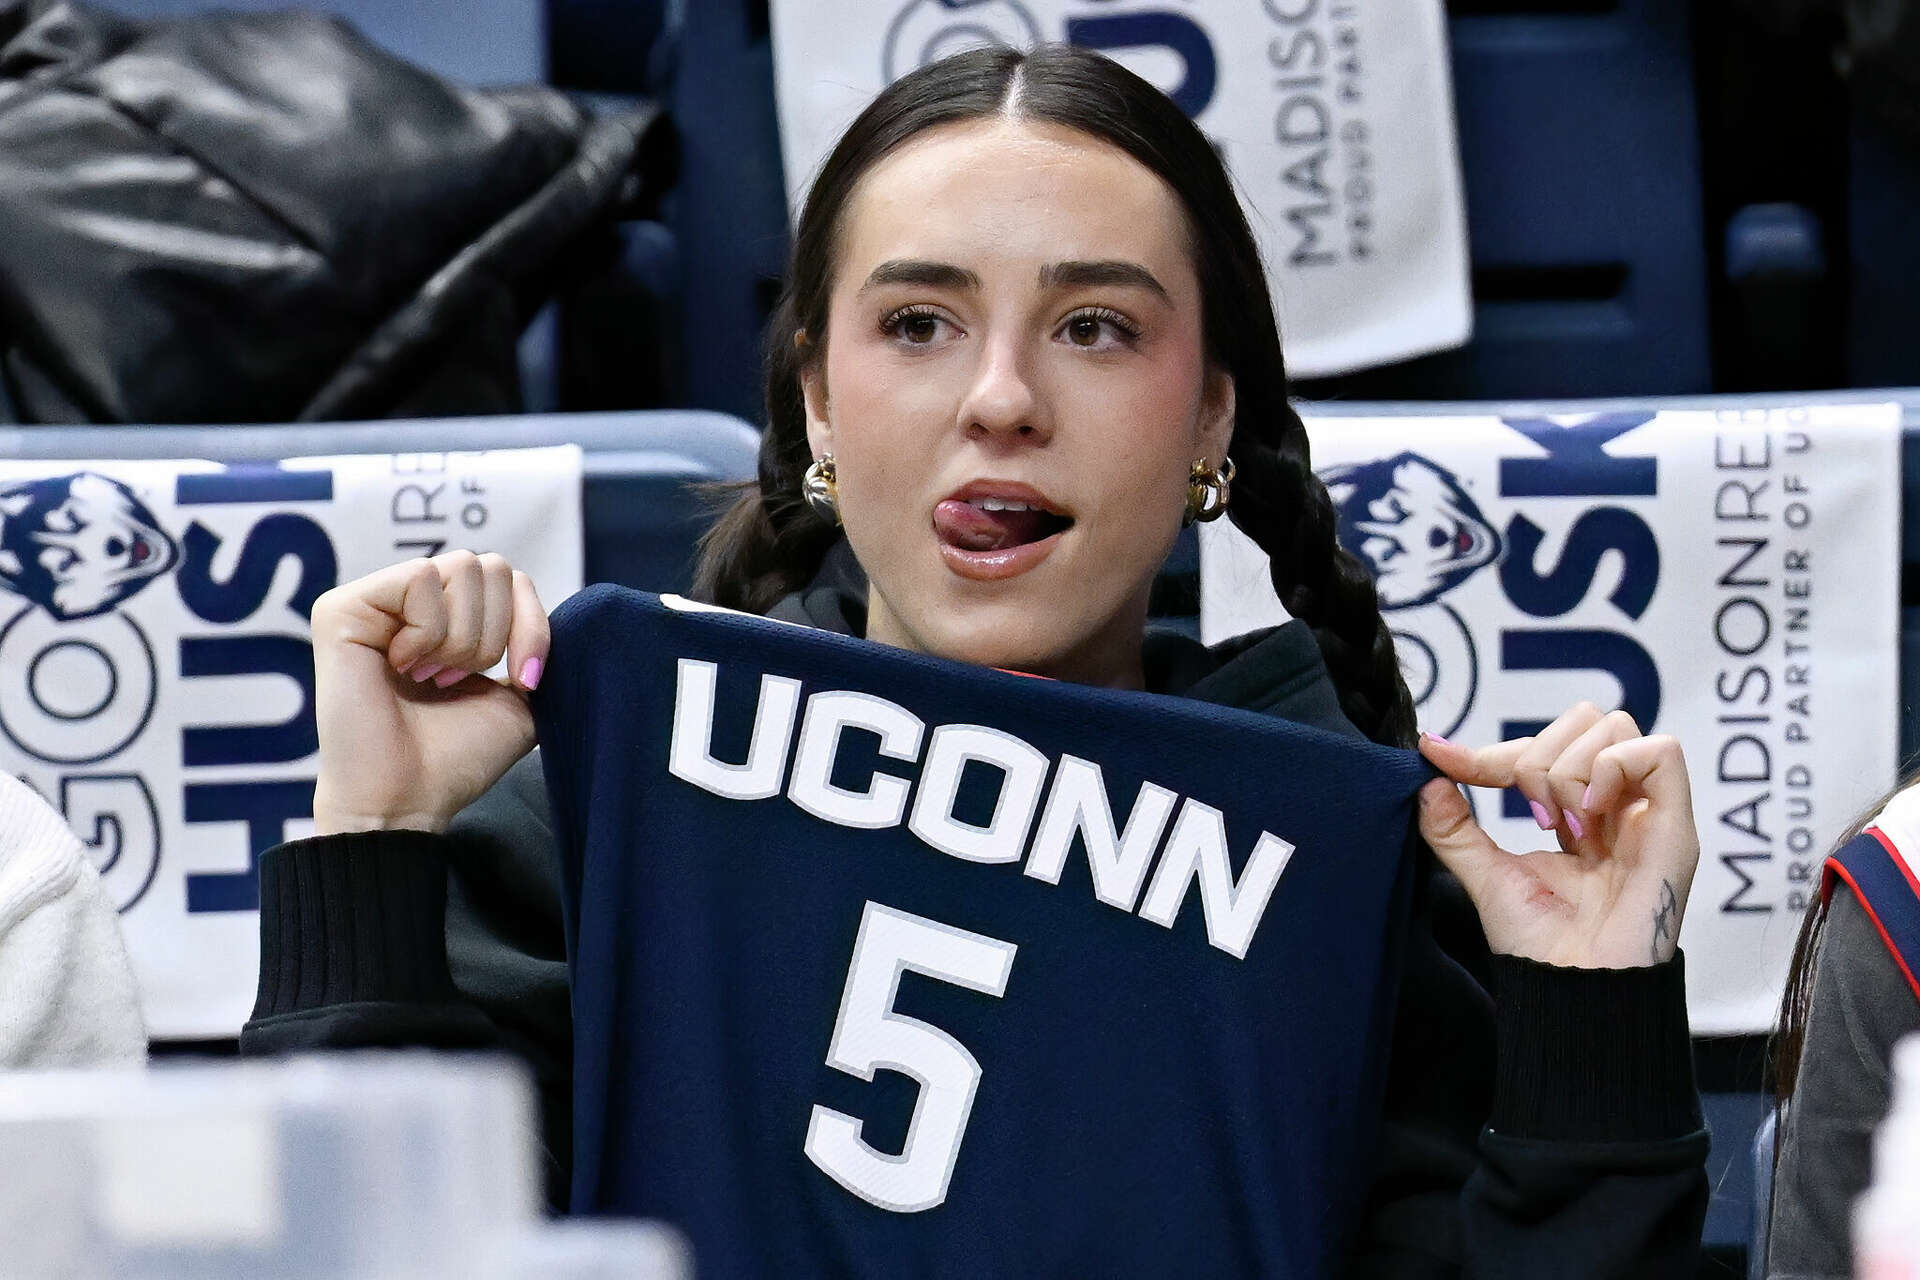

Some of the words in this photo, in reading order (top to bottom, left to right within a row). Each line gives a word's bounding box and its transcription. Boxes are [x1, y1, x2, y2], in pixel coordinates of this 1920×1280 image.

[1783, 473, 1811, 530] OF
[1783, 549, 1812, 743] PARTNER
[669, 658, 1296, 960] UCONN
[1784, 763, 1813, 912] PROUD
[804, 900, 1018, 1214] 5
